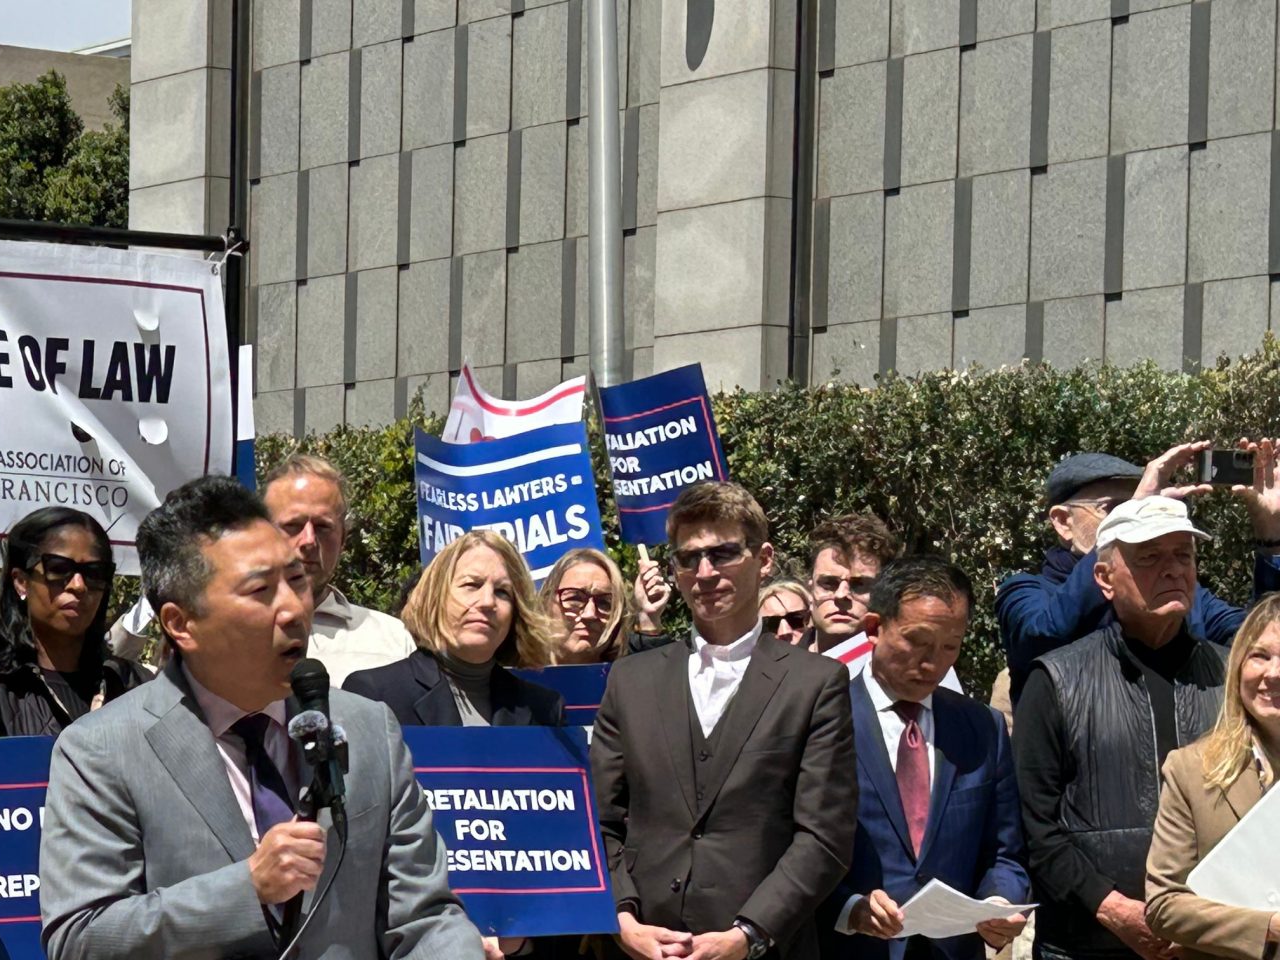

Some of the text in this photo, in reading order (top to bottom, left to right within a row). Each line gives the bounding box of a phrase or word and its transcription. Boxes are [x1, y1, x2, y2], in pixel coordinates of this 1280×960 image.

[18, 334, 69, 395] OF
[78, 339, 176, 403] LAW
[109, 459, 126, 477] OF
[420, 480, 479, 512] FEARLESS
[482, 473, 567, 510] LAWYERS
[455, 819, 506, 841] FOR
